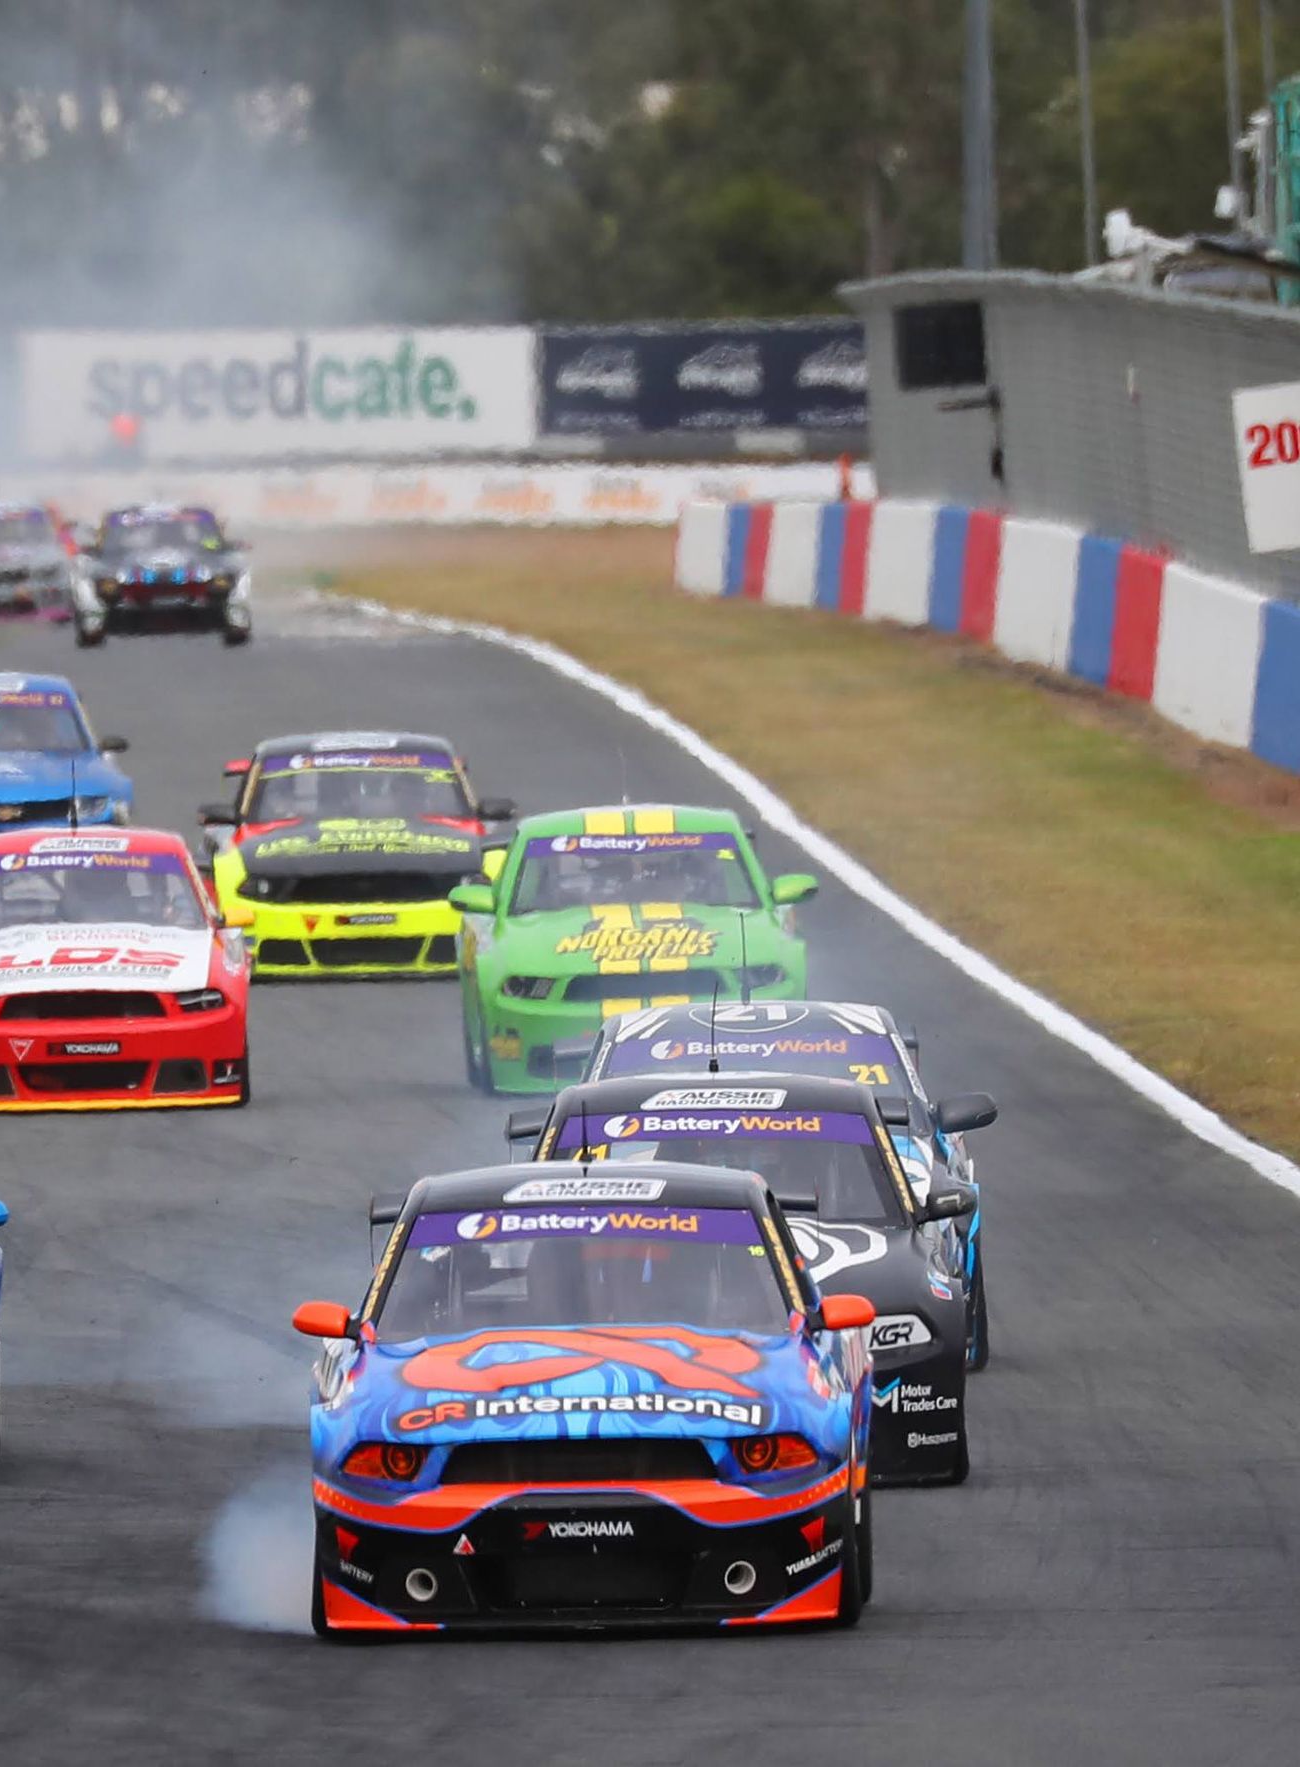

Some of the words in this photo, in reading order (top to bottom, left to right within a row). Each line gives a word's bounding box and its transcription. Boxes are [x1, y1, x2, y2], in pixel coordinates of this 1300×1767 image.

[89, 335, 479, 422] speedcafe.
[1246, 421, 1300, 469] 20
[579, 835, 702, 851] BatteryWorld
[709, 1004, 788, 1021] 21
[687, 1039, 847, 1057] BatteryWorld
[849, 1064, 890, 1085] 21
[680, 1090, 776, 1100] AUSSIE
[643, 1115, 821, 1134] BatteryWorld
[501, 1212, 699, 1234] BatteryWorld
[869, 1322, 915, 1348] KGR
[901, 1384, 932, 1398] Motor
[400, 1402, 467, 1431] CR
[475, 1394, 762, 1426] International
[902, 1397, 935, 1412] Trades
[936, 1396, 958, 1409] Care
[548, 1521, 634, 1538] YOKOHAMA
